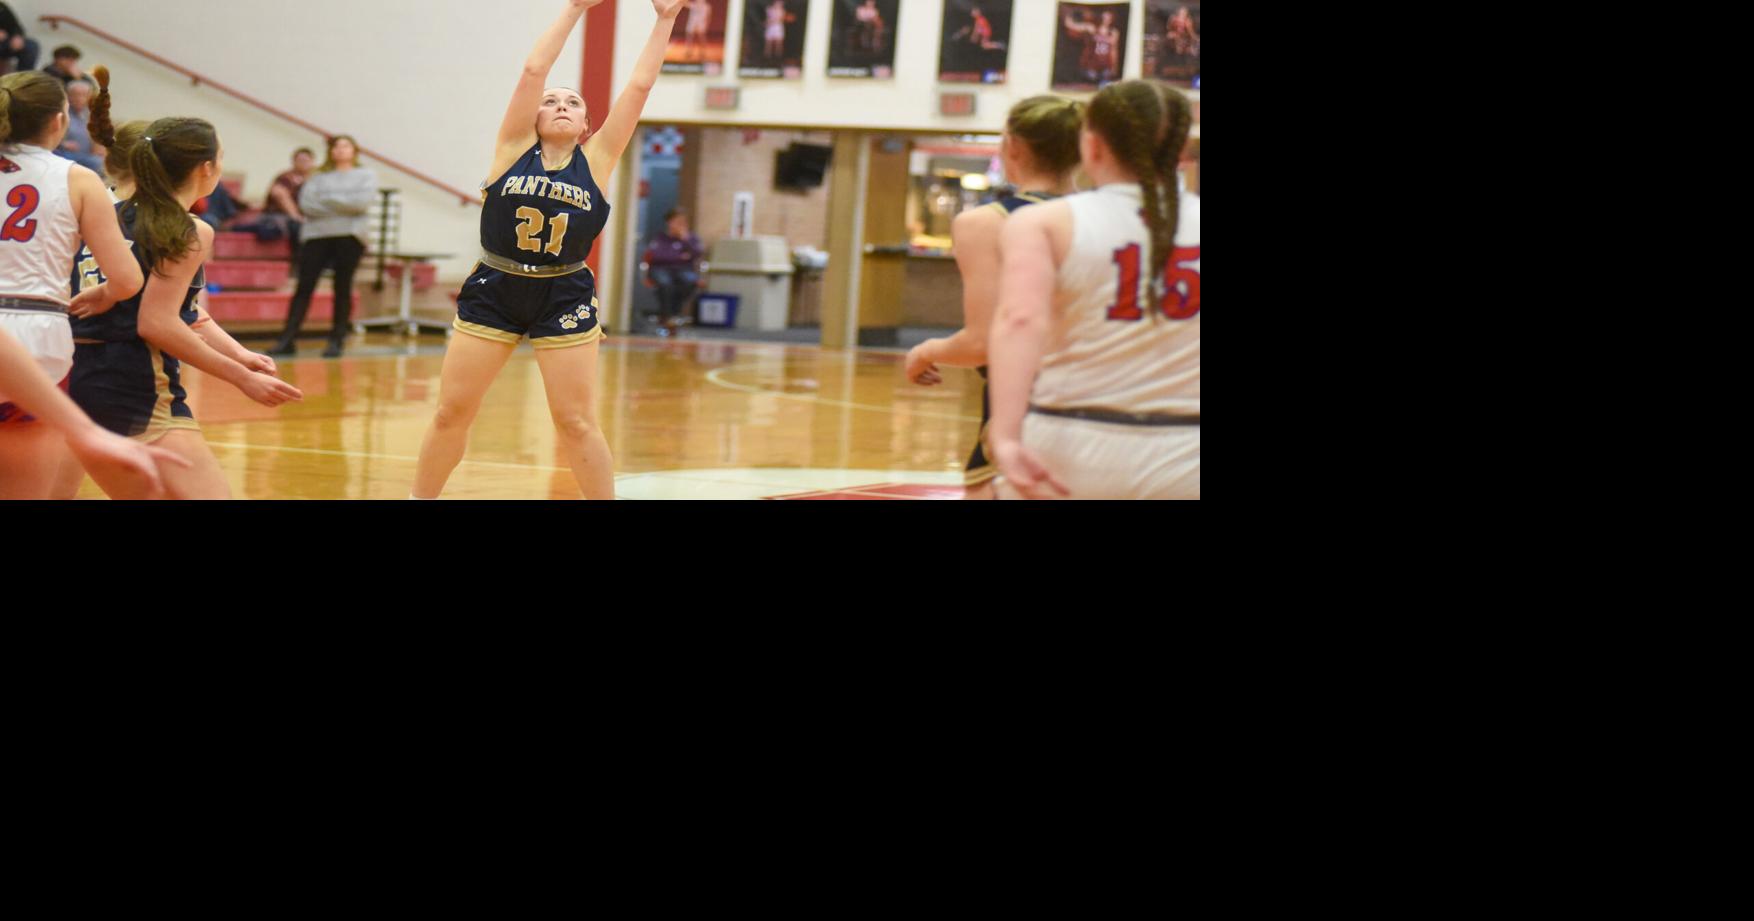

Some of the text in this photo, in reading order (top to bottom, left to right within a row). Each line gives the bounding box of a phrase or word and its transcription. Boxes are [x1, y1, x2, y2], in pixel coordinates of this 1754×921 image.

[0, 184, 40, 243] 2
[501, 176, 592, 212] PANTHERS
[515, 206, 569, 257] 21
[1106, 242, 1200, 321] 15
